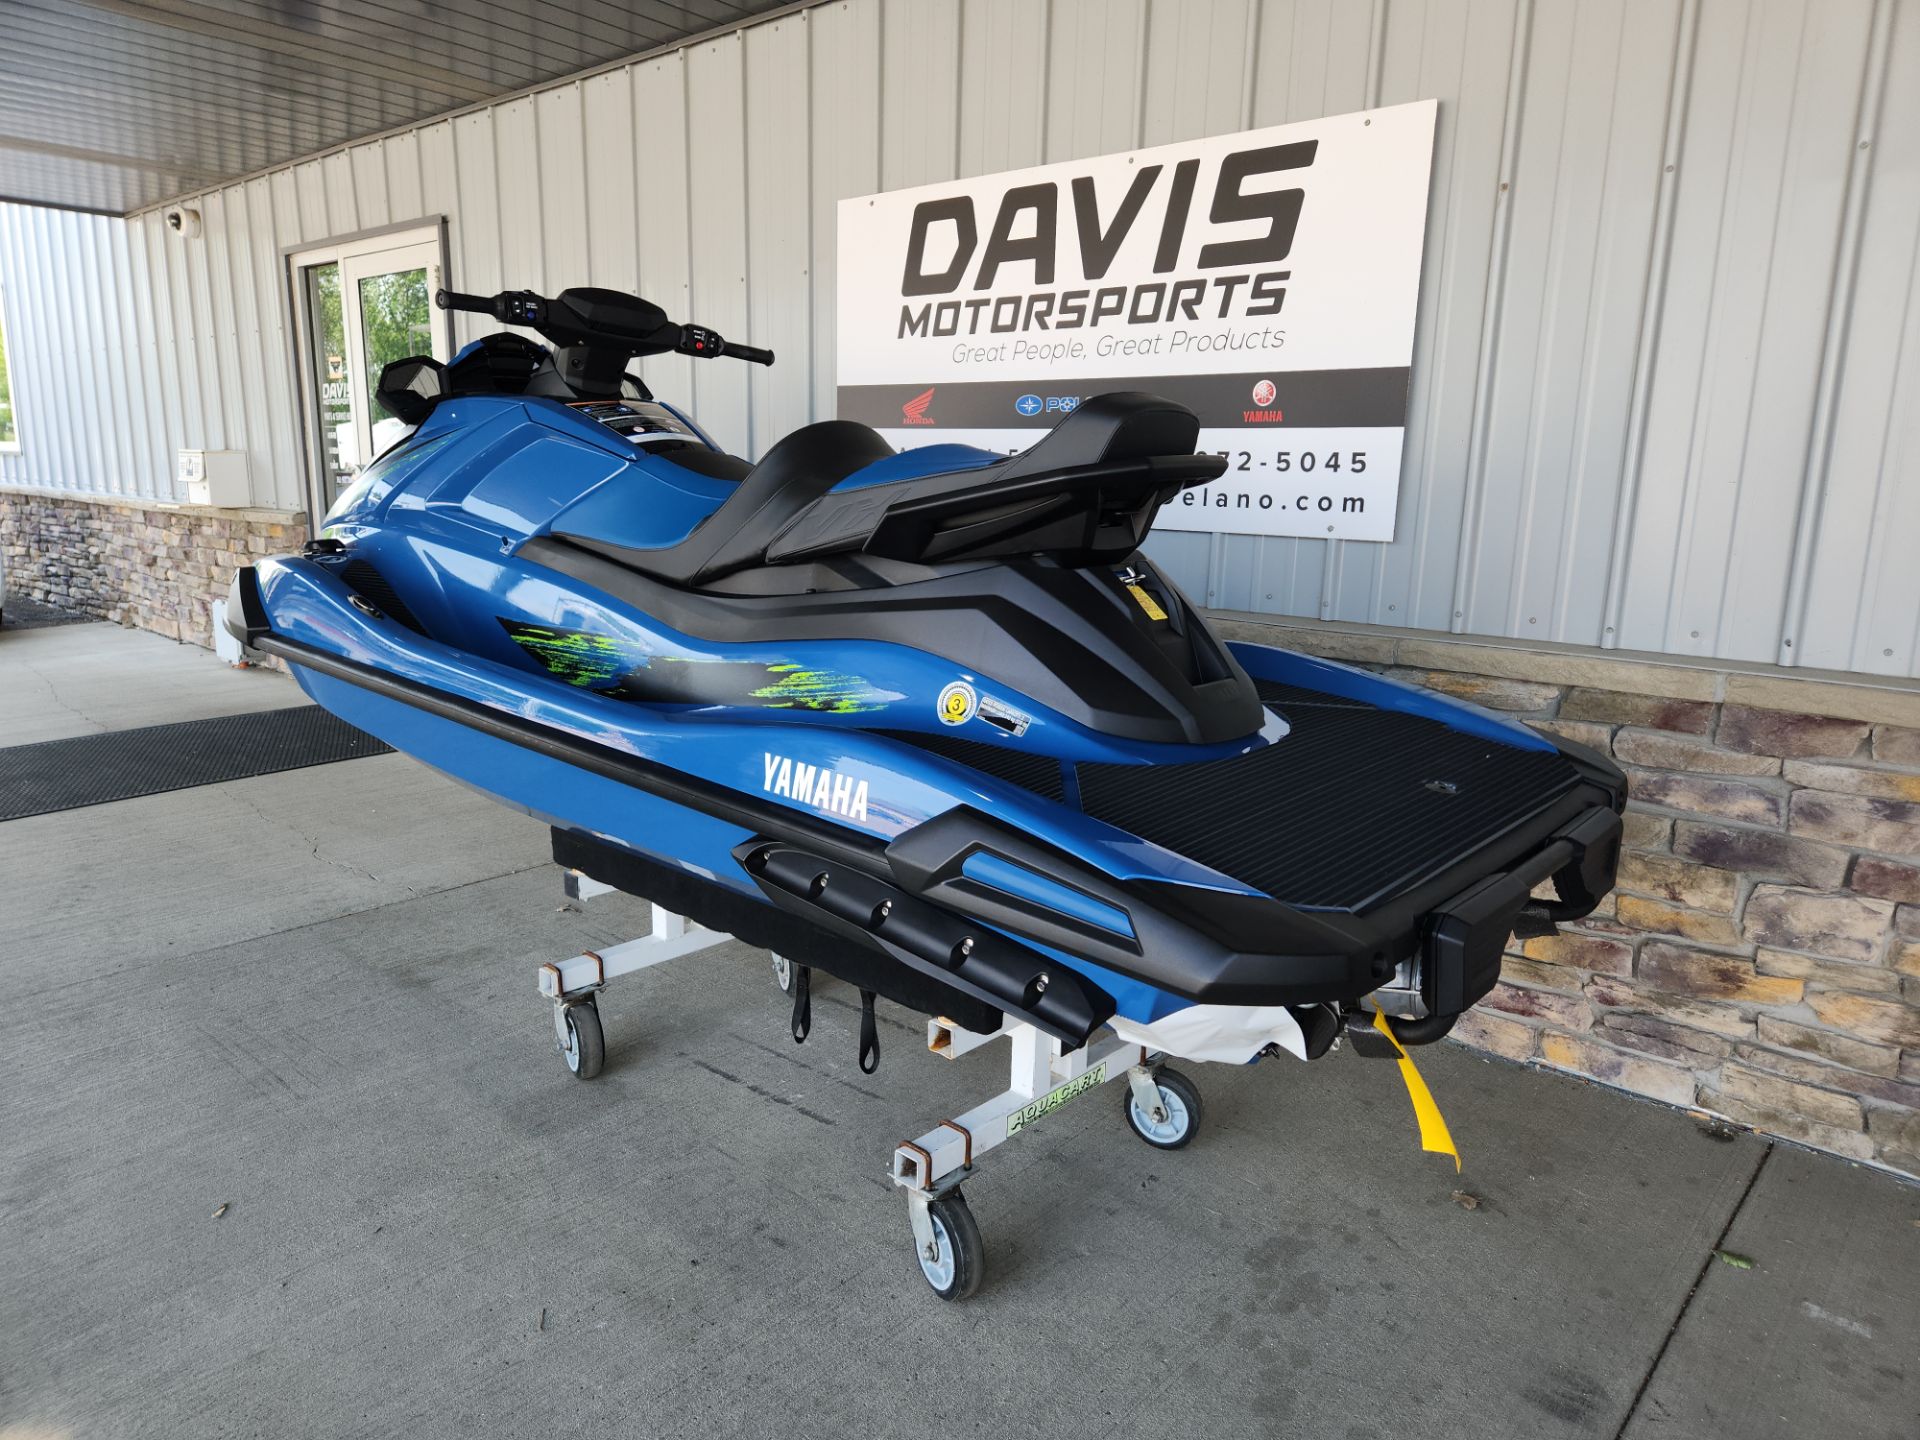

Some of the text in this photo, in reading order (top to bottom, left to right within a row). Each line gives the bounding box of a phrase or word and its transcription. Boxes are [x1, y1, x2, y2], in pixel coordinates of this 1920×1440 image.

[901, 139, 1319, 297] DAVIS
[898, 270, 1291, 339] MOTORSPORTS
[952, 327, 1285, 364] Great People, Great Products
[903, 416, 935, 425] HONDA
[1243, 410, 1283, 423] YAMAHA
[1162, 487, 1365, 513] elano.com
[952, 699, 960, 711] 3
[763, 751, 869, 822] YAMAHA
